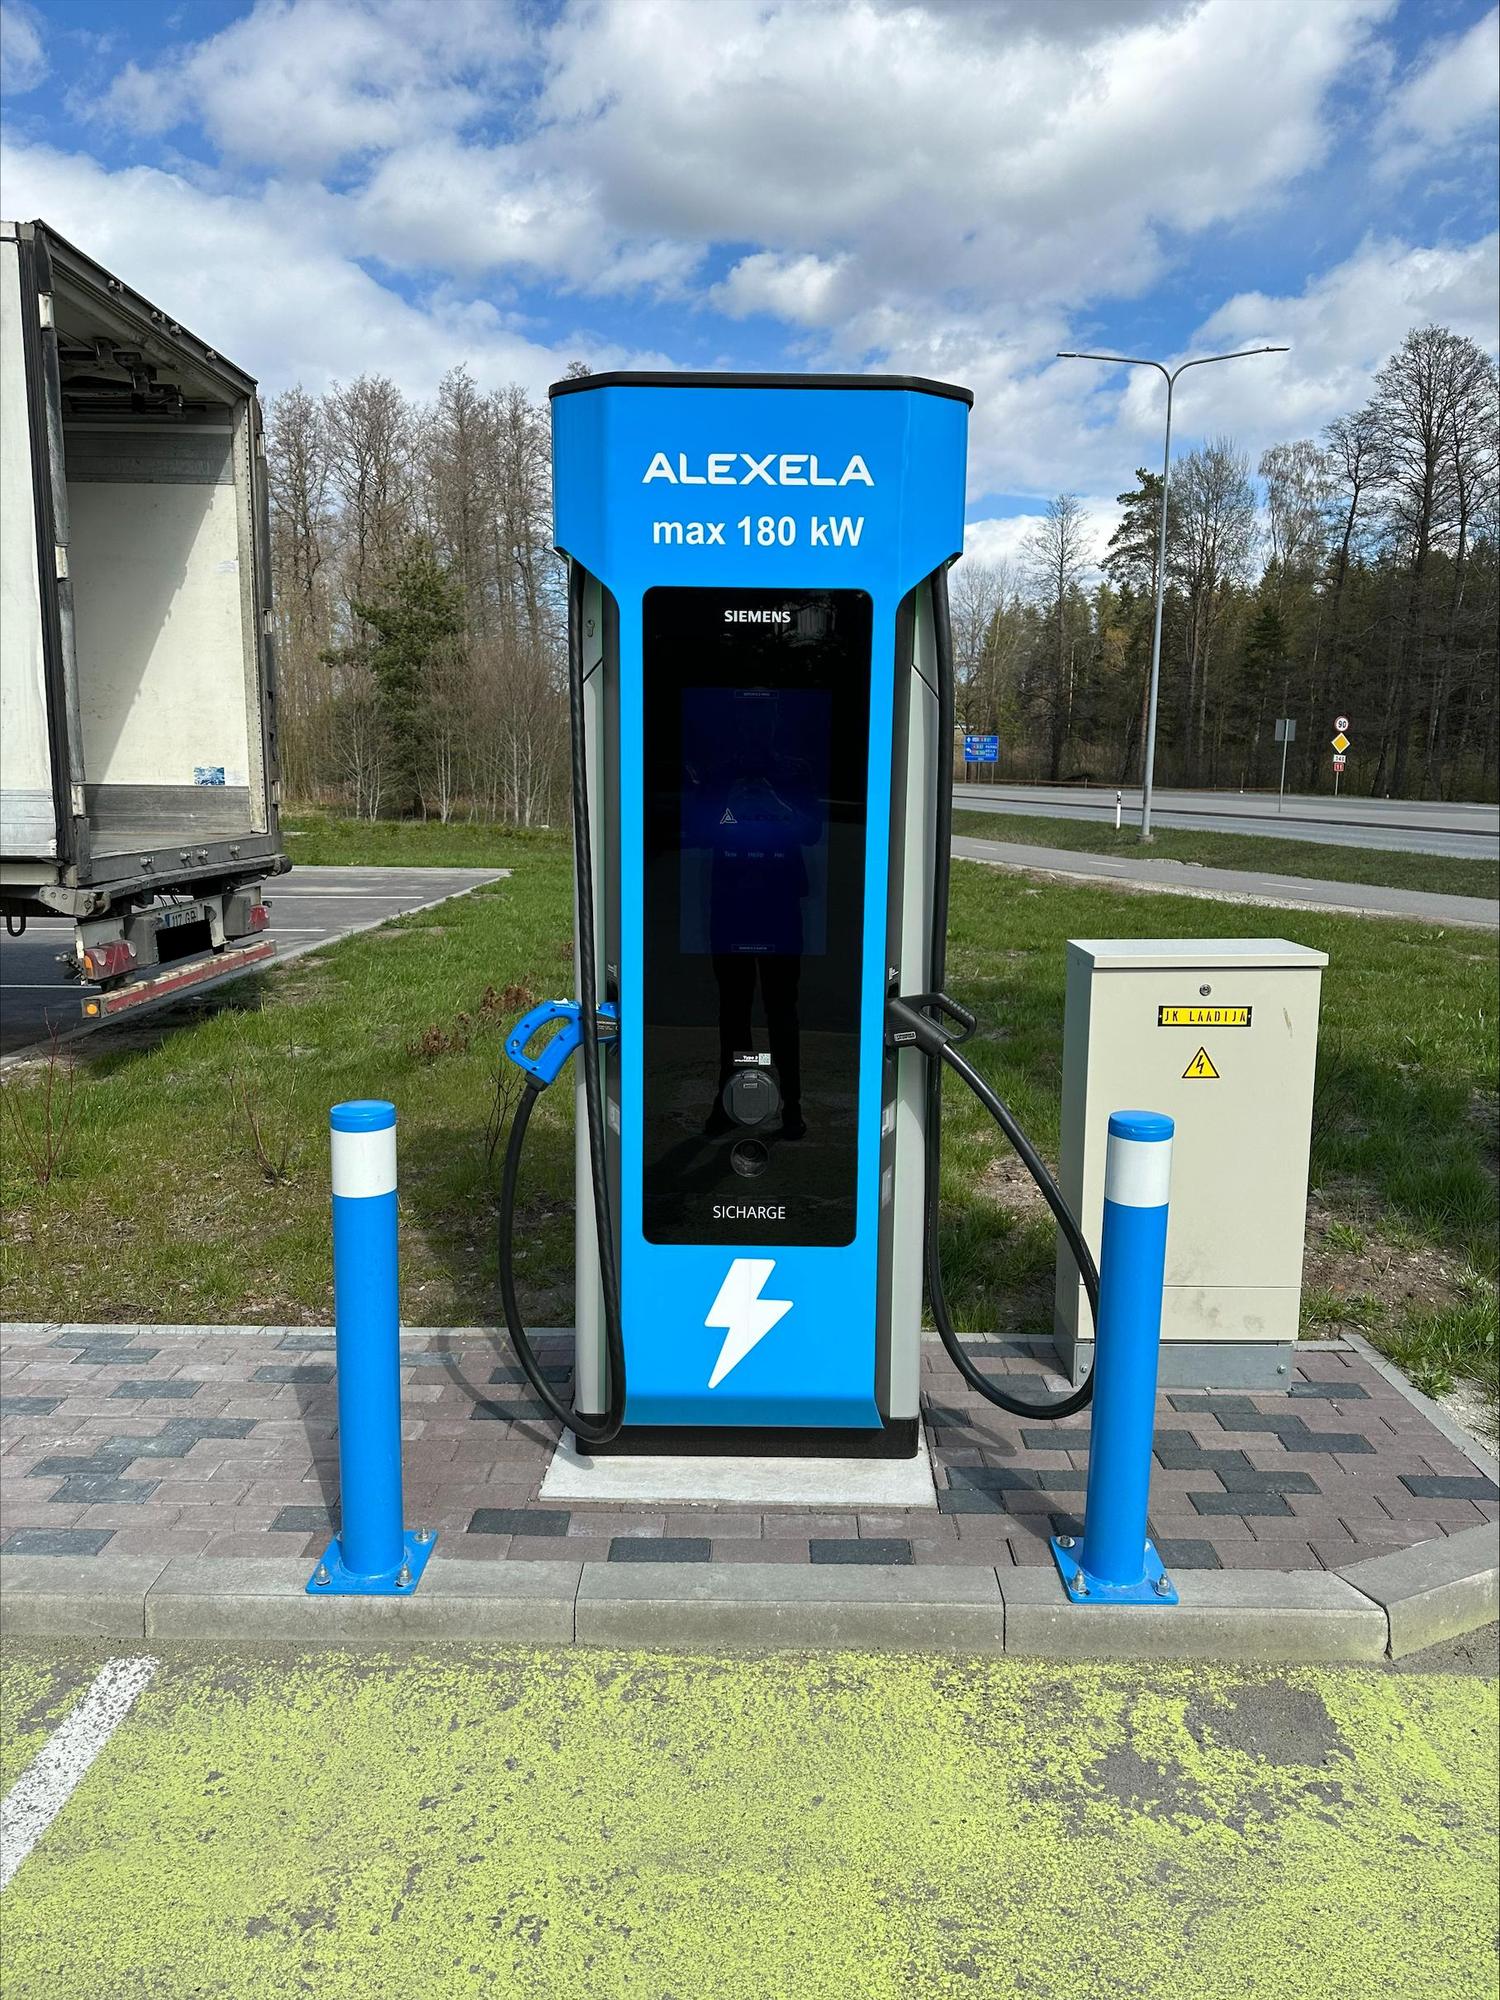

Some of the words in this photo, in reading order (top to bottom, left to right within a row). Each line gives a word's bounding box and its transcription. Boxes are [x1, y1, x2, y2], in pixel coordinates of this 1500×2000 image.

[641, 452, 875, 487] ALEXELA
[652, 521, 726, 545] max
[737, 515, 796, 547] 180
[810, 516, 865, 547] kW
[724, 610, 791, 623] SIEMENS
[1165, 1011, 1178, 1021] JK
[1189, 1011, 1246, 1021] LAADIJA
[713, 1205, 786, 1219] SICHARGE
